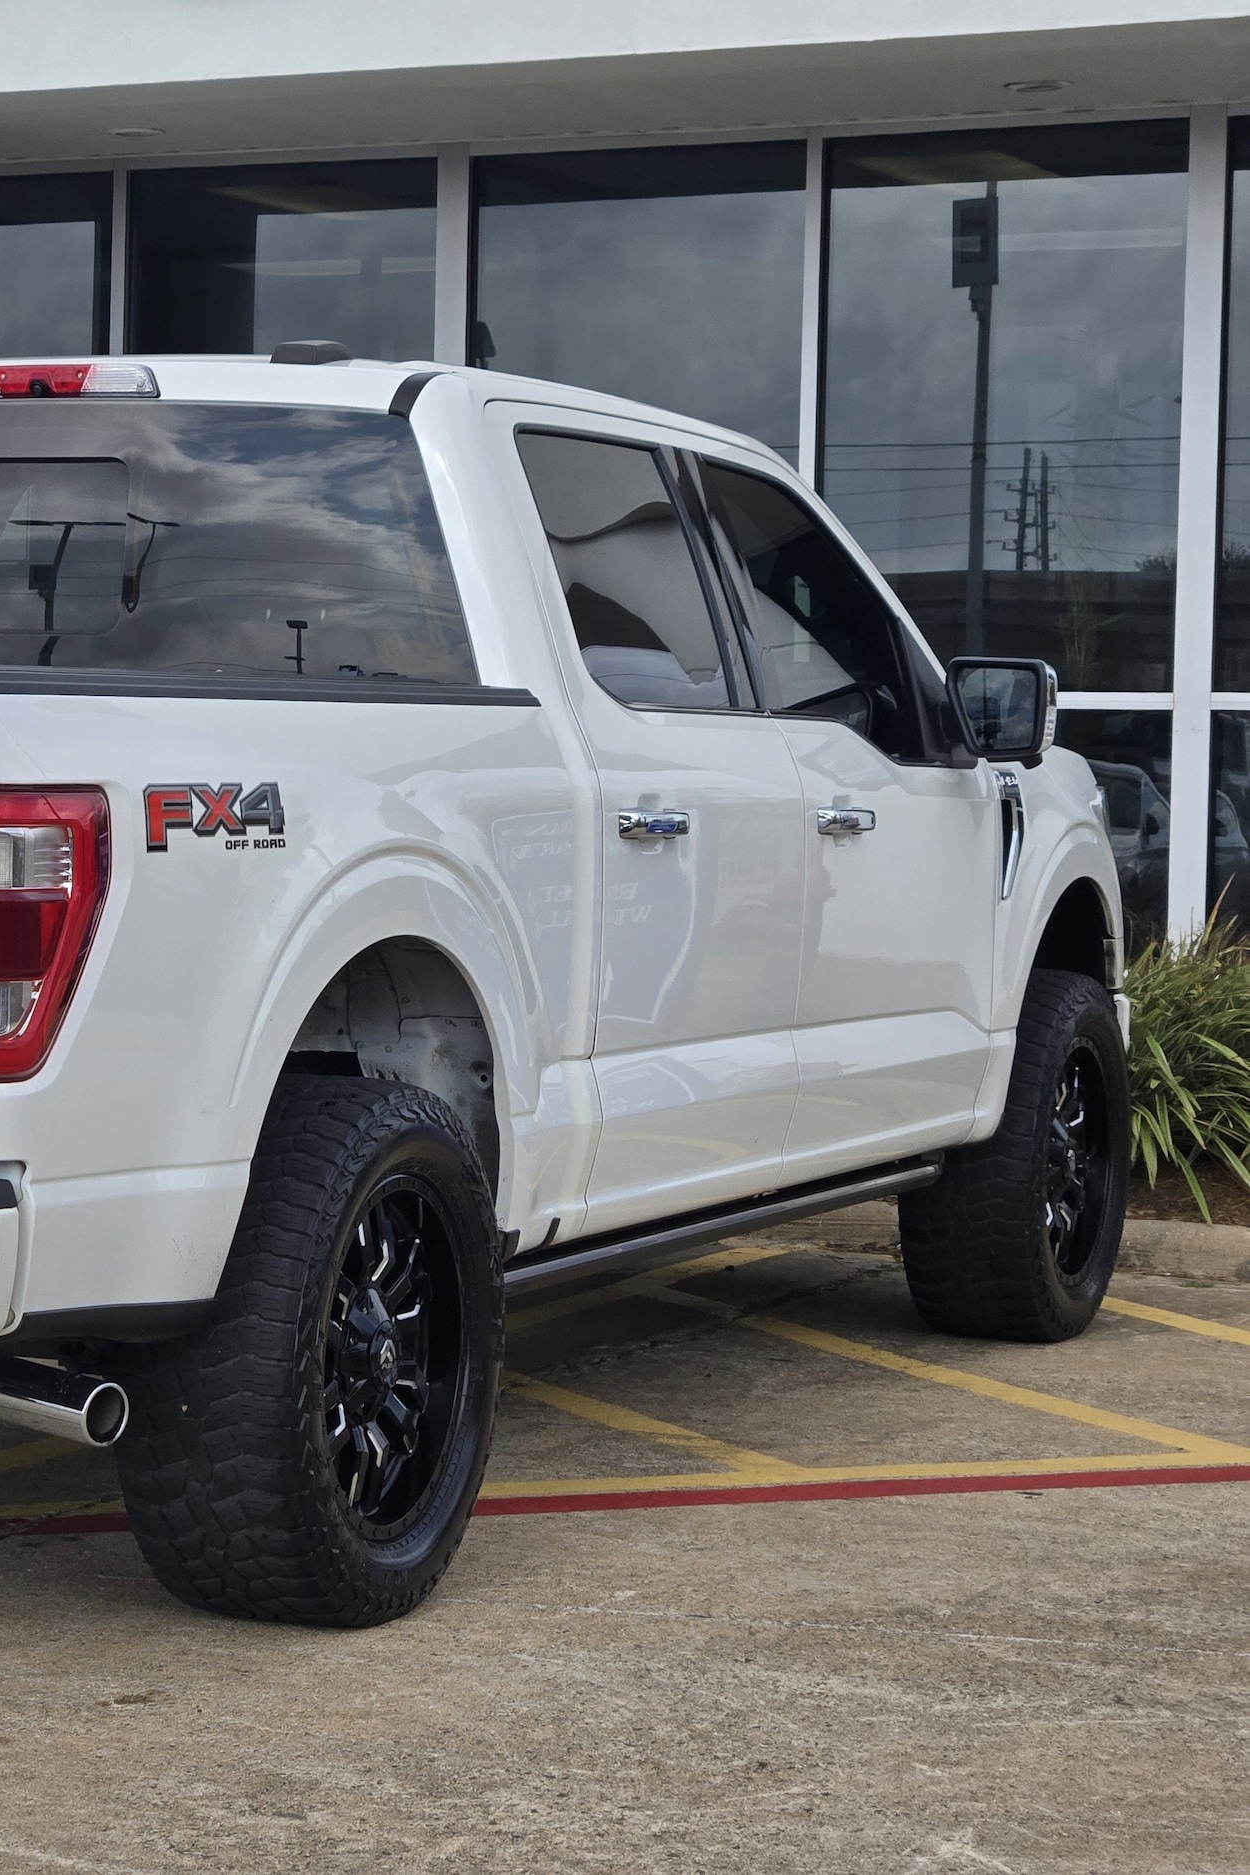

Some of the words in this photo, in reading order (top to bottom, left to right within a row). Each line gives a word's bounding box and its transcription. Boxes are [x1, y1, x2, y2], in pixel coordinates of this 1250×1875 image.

[143, 782, 285, 853] FX4
[225, 839, 249, 850] OFF
[254, 838, 286, 849] ROAD
